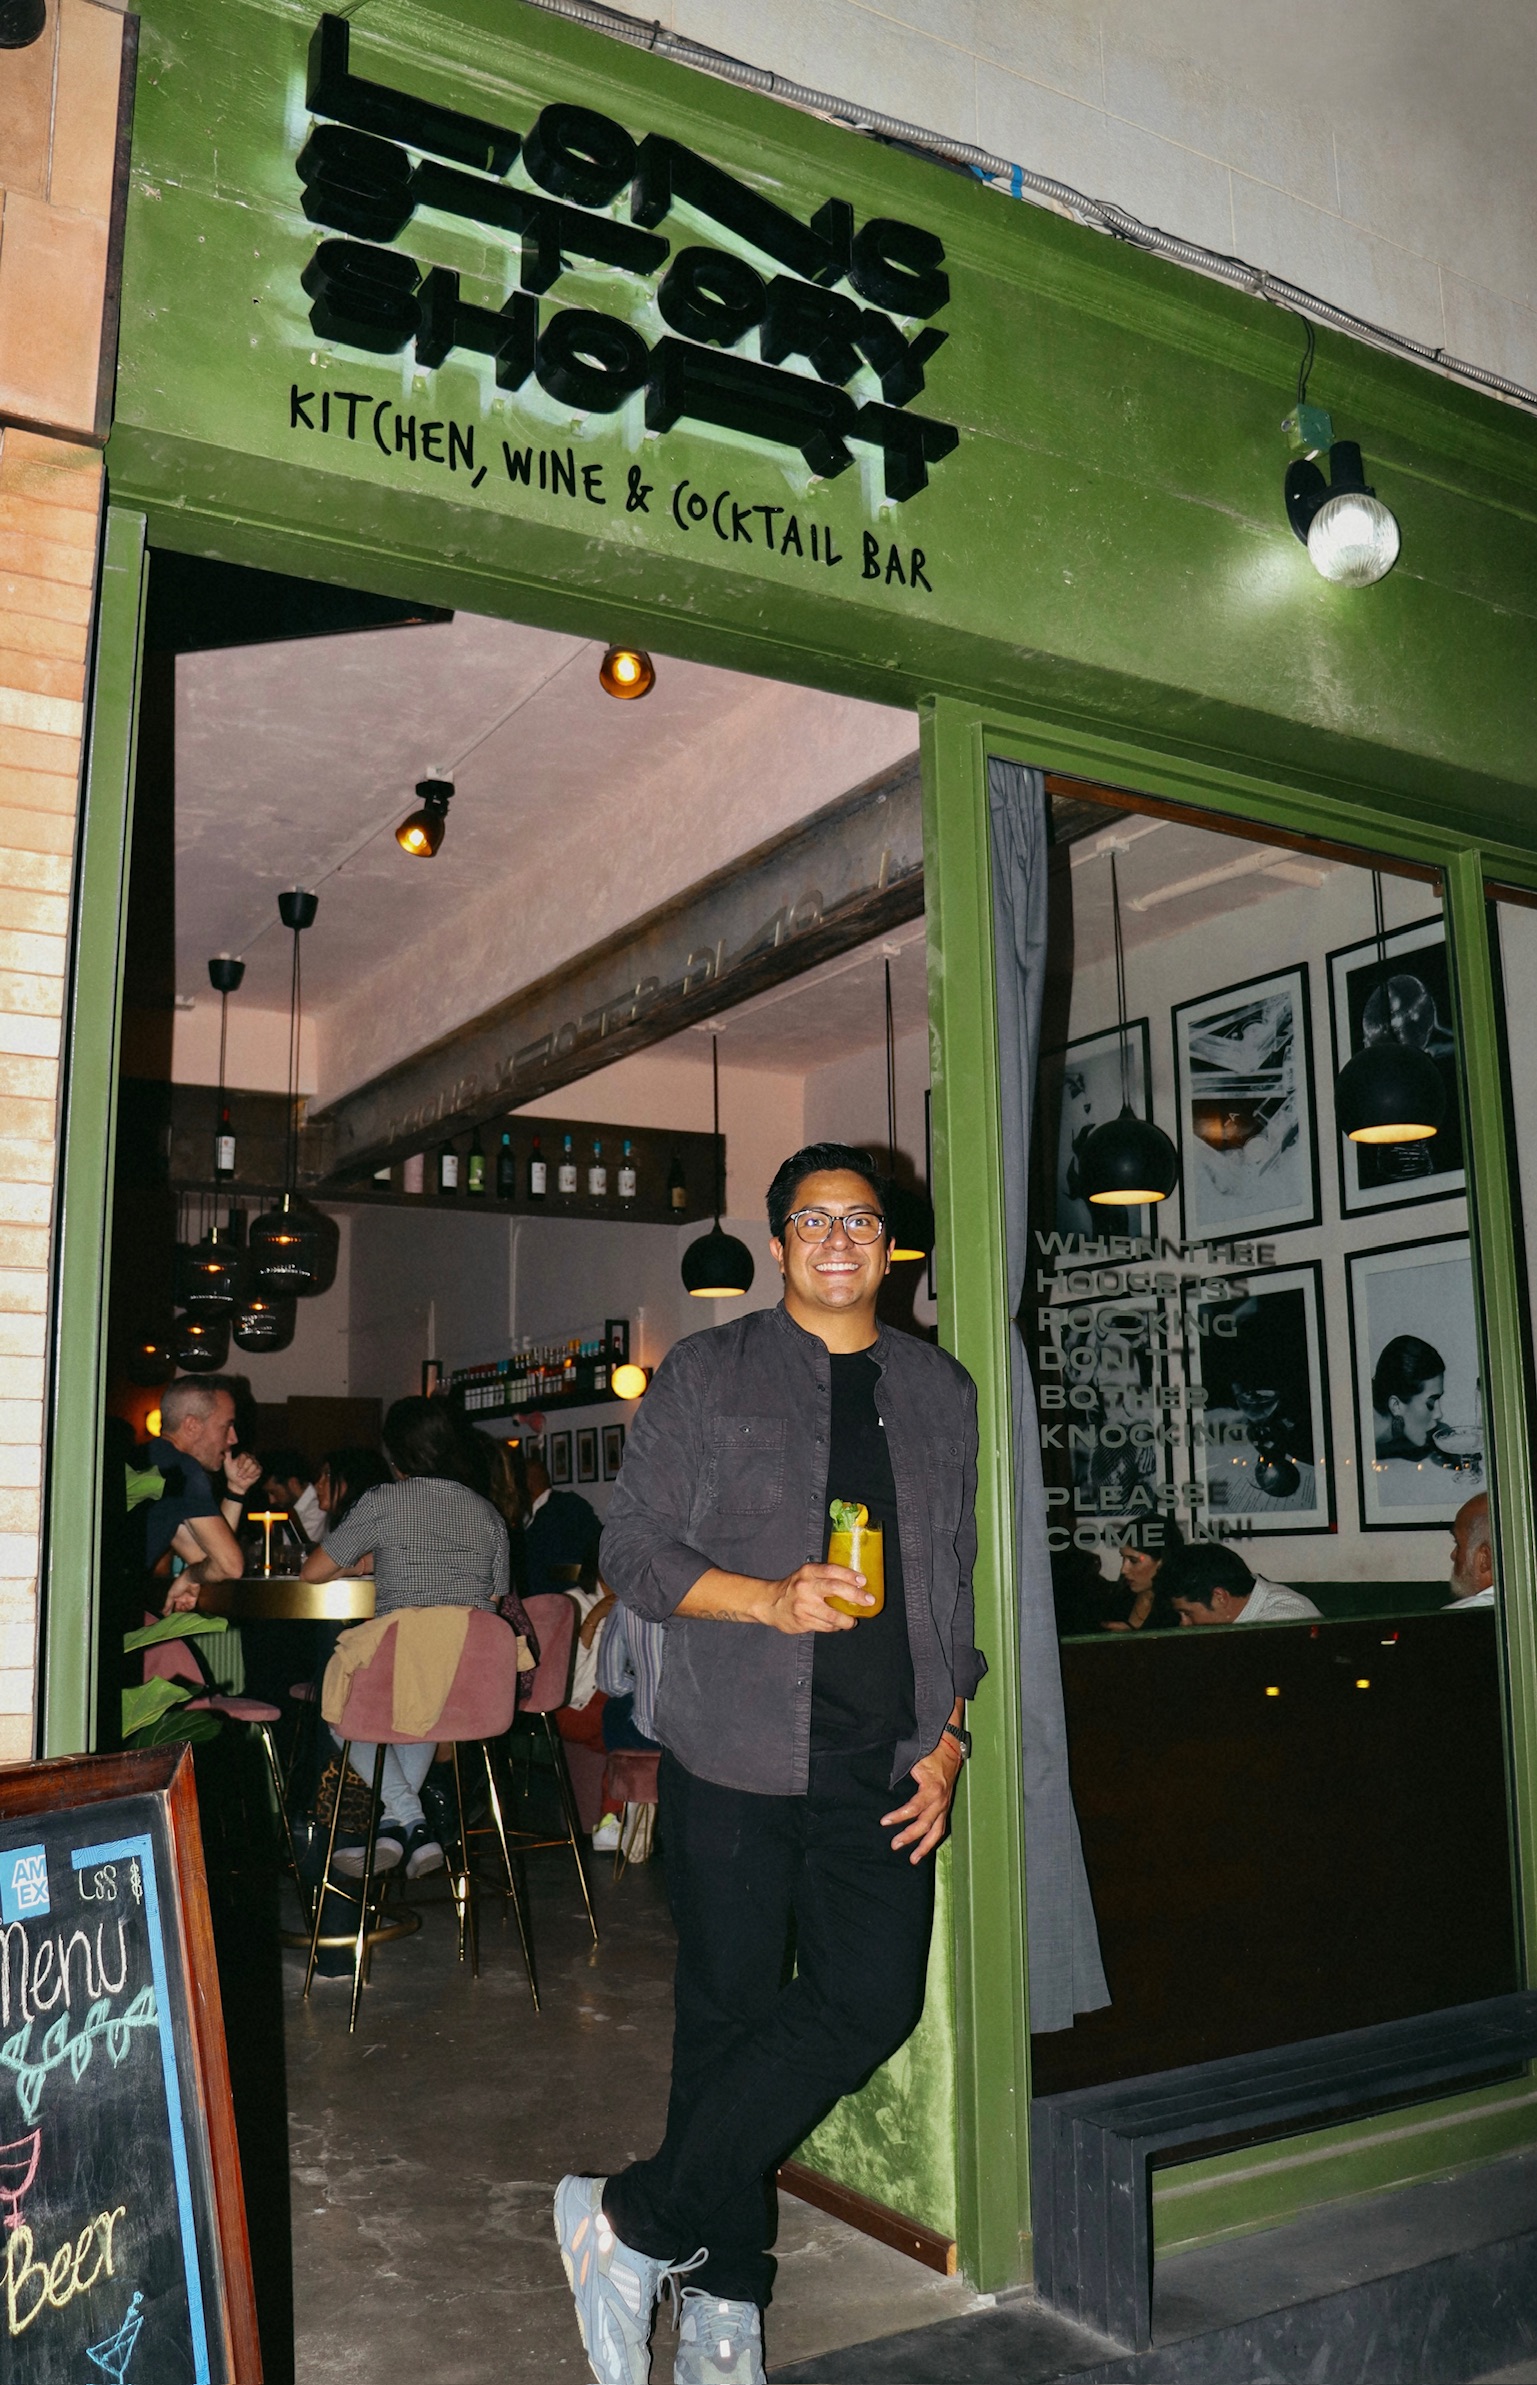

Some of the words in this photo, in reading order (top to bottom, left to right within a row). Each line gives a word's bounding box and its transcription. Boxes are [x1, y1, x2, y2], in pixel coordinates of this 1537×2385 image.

[306, 13, 950, 319] LONG
[296, 123, 949, 408] STORY
[301, 239, 960, 503] SHORT
[290, 384, 488, 489] KITCHEN,
[502, 441, 606, 505] WINE
[625, 464, 654, 513] &
[672, 480, 843, 567] COCKTAIL
[861, 530, 933, 593] BAR
[1034, 1230, 1161, 1261] WHEN
[1180, 1240, 1256, 1267] THE
[1037, 1269, 1178, 1299] HOUSE
[1038, 1306, 1238, 1338] ROCKING
[1039, 1384, 1209, 1410] BOTHER
[1044, 1482, 1206, 1512] PLEASE
[1046, 1522, 1165, 1552] COME
[0, 2205, 127, 2335] Beer
